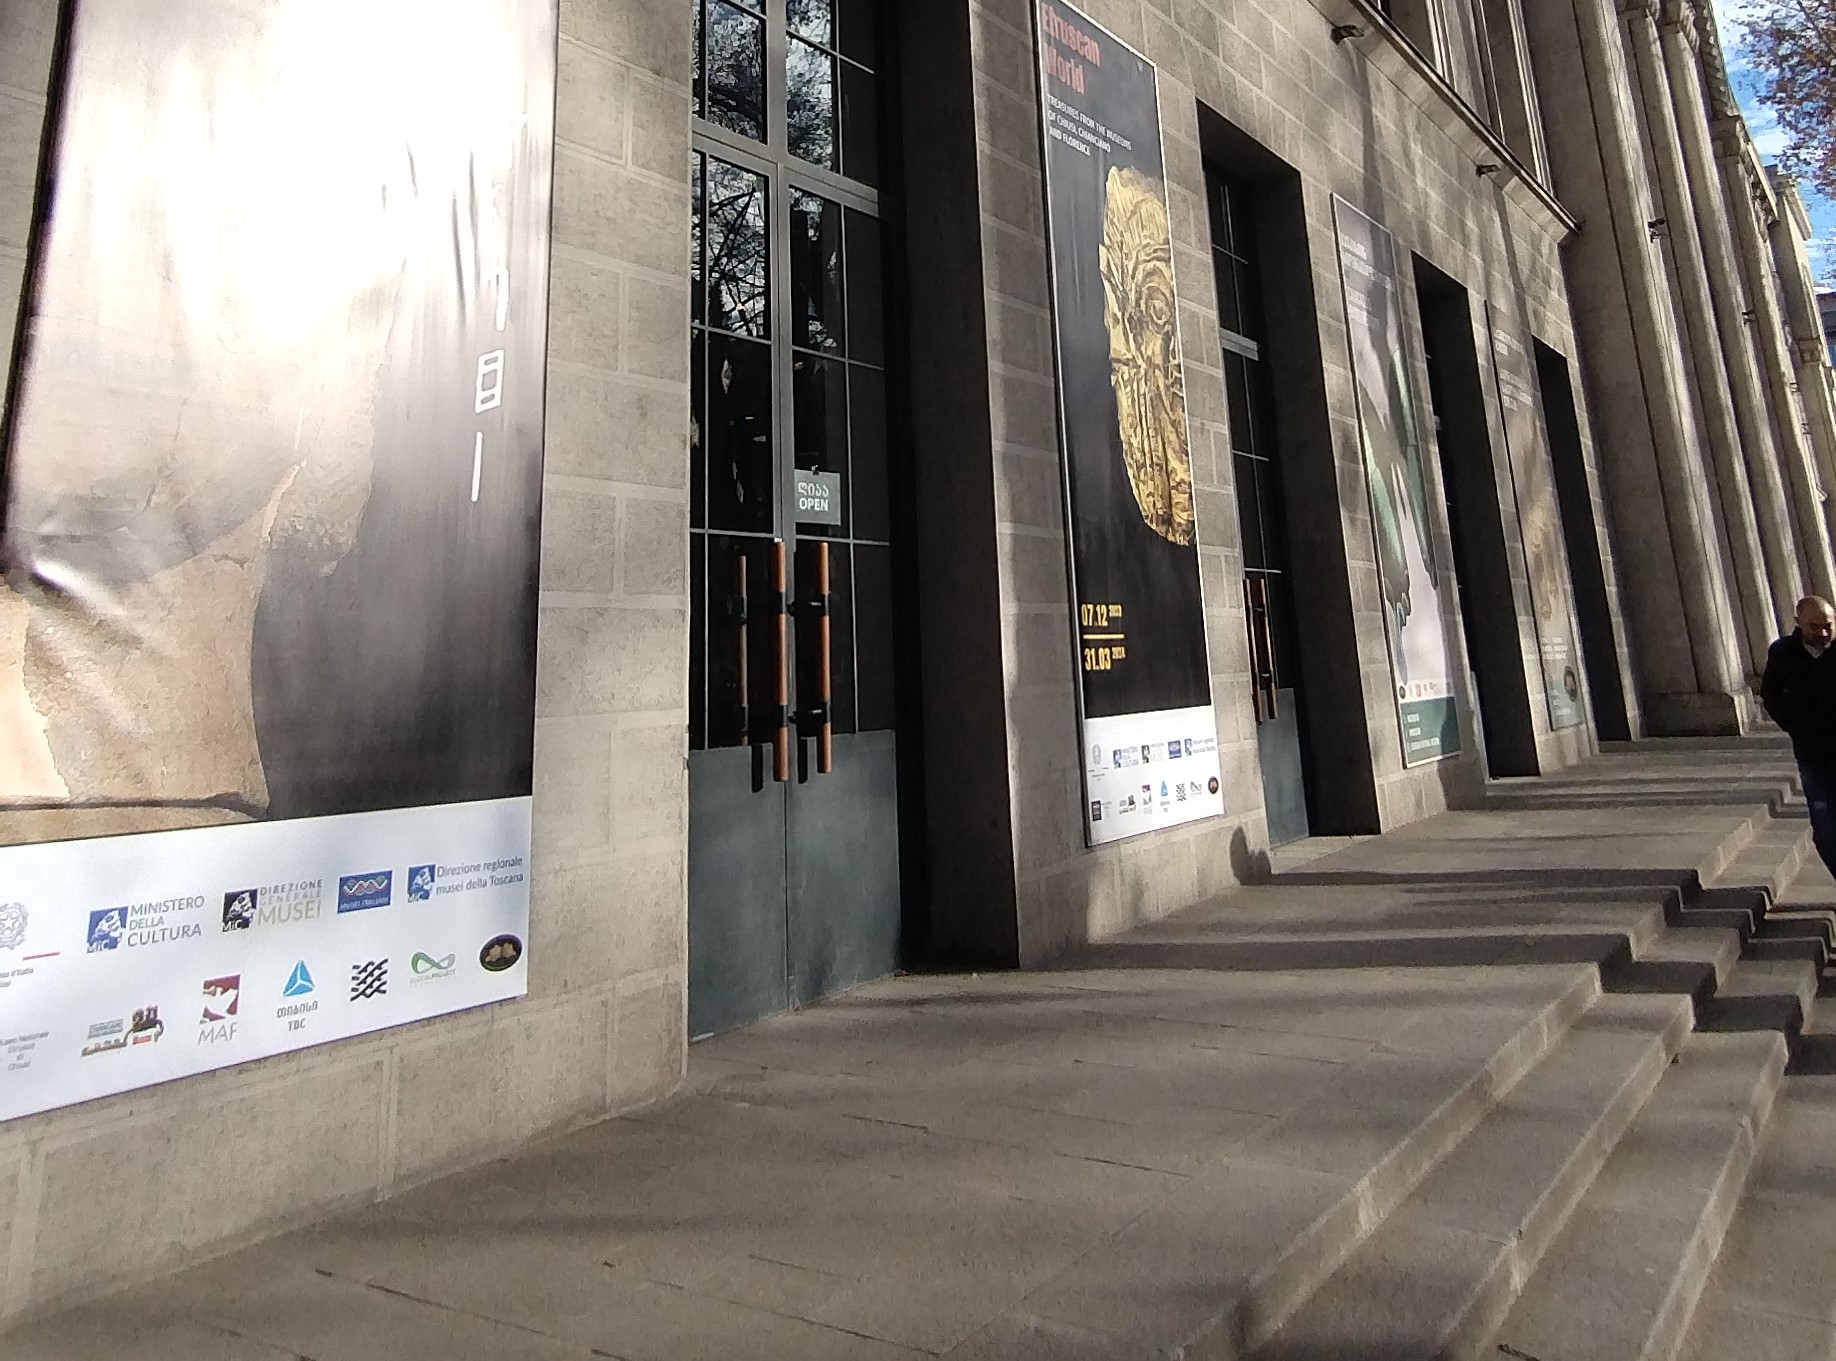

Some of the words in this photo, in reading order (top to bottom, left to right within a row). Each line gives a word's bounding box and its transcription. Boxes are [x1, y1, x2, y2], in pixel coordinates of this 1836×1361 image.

[798, 482, 829, 497] ღიაა
[800, 498, 828, 511] OPEN
[1081, 604, 1108, 626] 07.12
[1084, 648, 1111, 670] 31.03
[437, 864, 481, 878] Direzione
[483, 856, 523, 873] regionale
[260, 879, 323, 896] DIREZIONE
[436, 884, 463, 895] musei
[466, 879, 487, 890] della
[490, 873, 524, 887] Toscana
[130, 895, 205, 917] MINISTERO
[259, 890, 321, 906] GENERALE
[129, 916, 165, 931] DELLA
[257, 900, 321, 927] MUSEI
[127, 924, 201, 948] CULTURA
[277, 1000, 318, 1019] თიბისი
[198, 1023, 237, 1047] MAF
[288, 1018, 306, 1031] TBC
